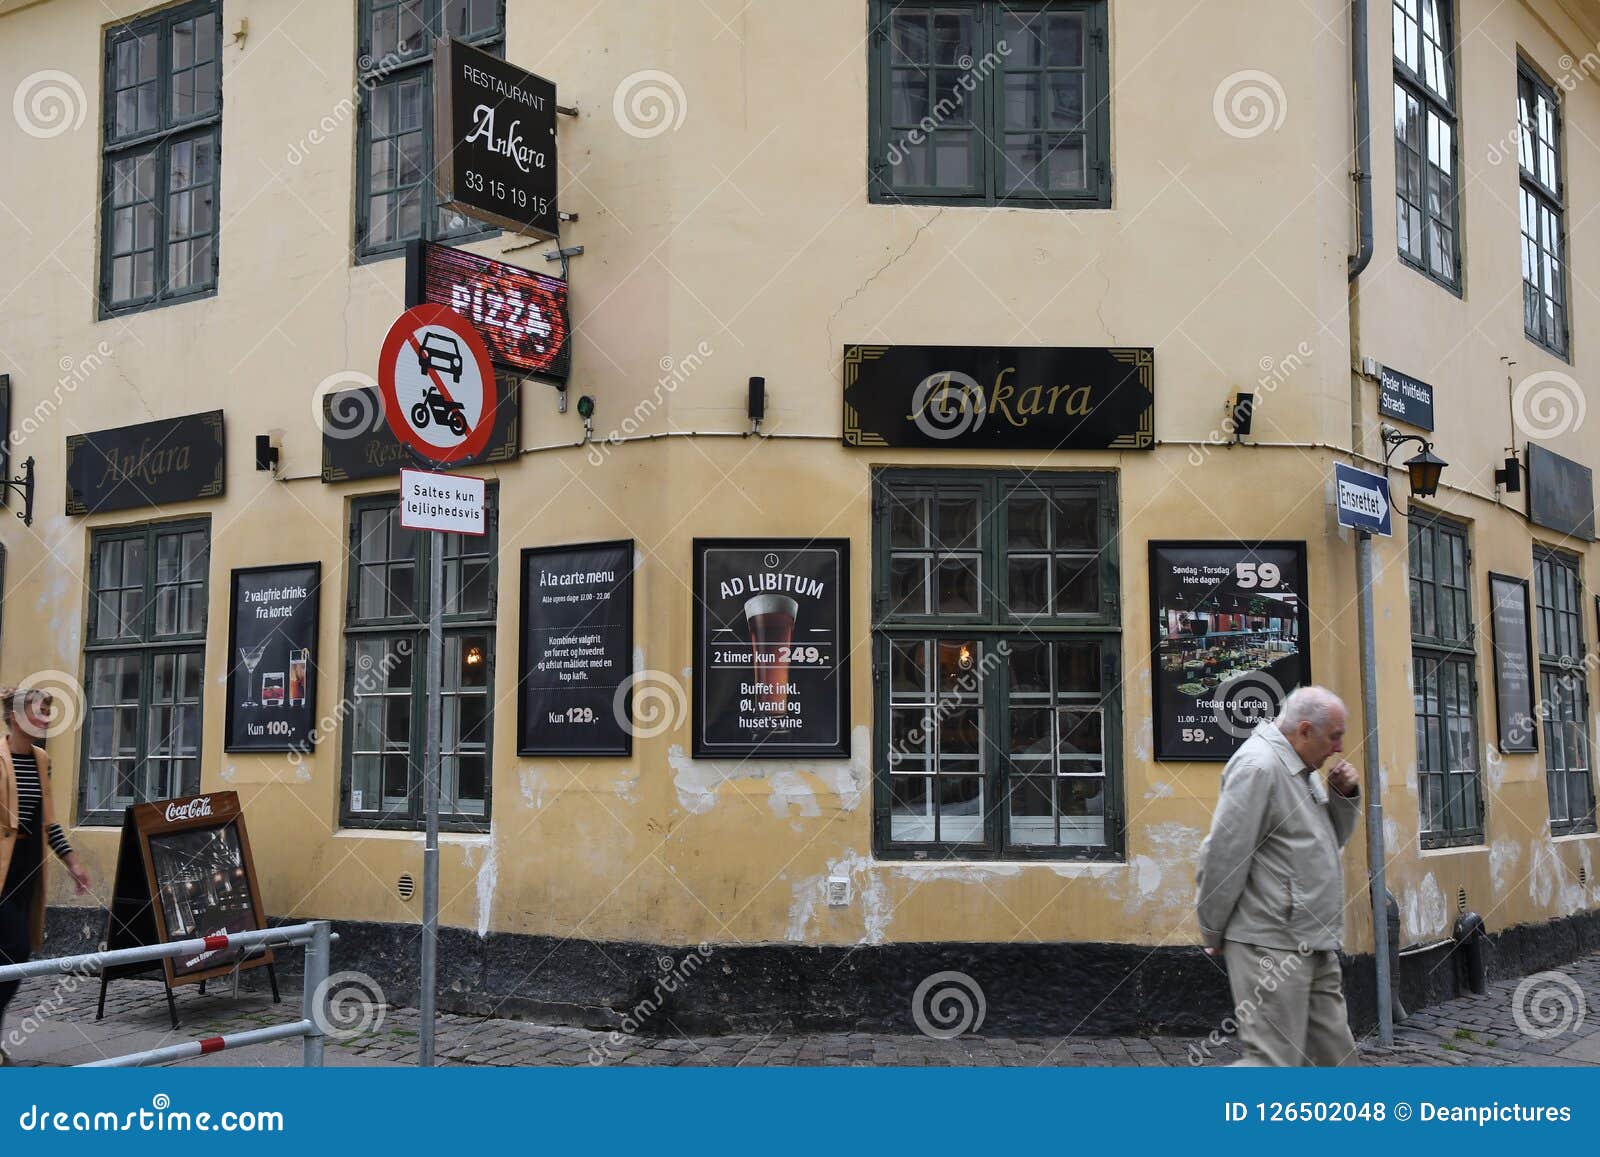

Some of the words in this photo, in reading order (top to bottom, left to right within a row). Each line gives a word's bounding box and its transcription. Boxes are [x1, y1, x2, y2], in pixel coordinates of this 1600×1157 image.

[463, 64, 545, 112] RESTAURANT
[464, 104, 547, 173] Ankara
[465, 170, 484, 192] 33
[489, 179, 506, 200] 15
[510, 187, 527, 208] 19
[532, 195, 548, 215] 15
[905, 366, 1094, 427] Ankara
[1382, 372, 1400, 392] Peder
[1401, 380, 1431, 405] Hvitfeldts
[1382, 392, 1406, 414] Stræde
[97, 437, 193, 488] Ankara
[413, 484, 451, 500] Saltes
[455, 489, 475, 502] kun
[1339, 484, 1380, 515] Ensrettet
[407, 501, 480, 520] lejlighedsvis
[548, 572, 558, 586] la
[559, 571, 585, 586] carte
[586, 570, 615, 584] menu
[1172, 565, 1198, 575] Søndag
[1203, 565, 1230, 576] Torsdag
[1235, 562, 1290, 590] 59,-
[720, 577, 744, 600] AD
[748, 573, 825, 600] LIBITUM
[1183, 576, 1199, 584] Hele
[1199, 576, 1221, 585] dagen
[244, 591, 250, 602] 2
[251, 589, 281, 605] valgfrie
[281, 586, 307, 600] drinks
[255, 606, 268, 619] fra
[269, 605, 293, 618] kortet
[578, 634, 601, 646] valgfrit
[544, 649, 552, 658] en
[552, 647, 570, 657] forret
[570, 648, 578, 659] og
[578, 646, 605, 656] hovedret
[714, 651, 721, 663] 2
[723, 650, 752, 663] timer
[755, 651, 776, 663] kun
[778, 646, 829, 665] 249,-
[537, 661, 545, 671] og
[545, 660, 563, 669] afslut
[589, 658, 603, 668] med
[603, 659, 613, 667] en
[559, 671, 572, 682] kop
[740, 682, 773, 695] Buffet
[776, 682, 801, 695] inkl.
[740, 698, 756, 714] Øl,
[758, 699, 785, 712] vand
[787, 702, 801, 715] og
[1196, 698, 1225, 710] Fredag
[1226, 700, 1237, 711] og
[1238, 699, 1268, 711] Lørdag
[548, 711, 564, 724] Kun
[566, 707, 600, 725] 129,-
[738, 716, 778, 728] huset's
[779, 716, 803, 728] vine
[1177, 715, 1195, 723] 11.00
[1200, 715, 1218, 723] 17.00
[248, 722, 264, 736] Kun
[266, 720, 296, 738] 100,-
[1182, 728, 1214, 744] 59,-
